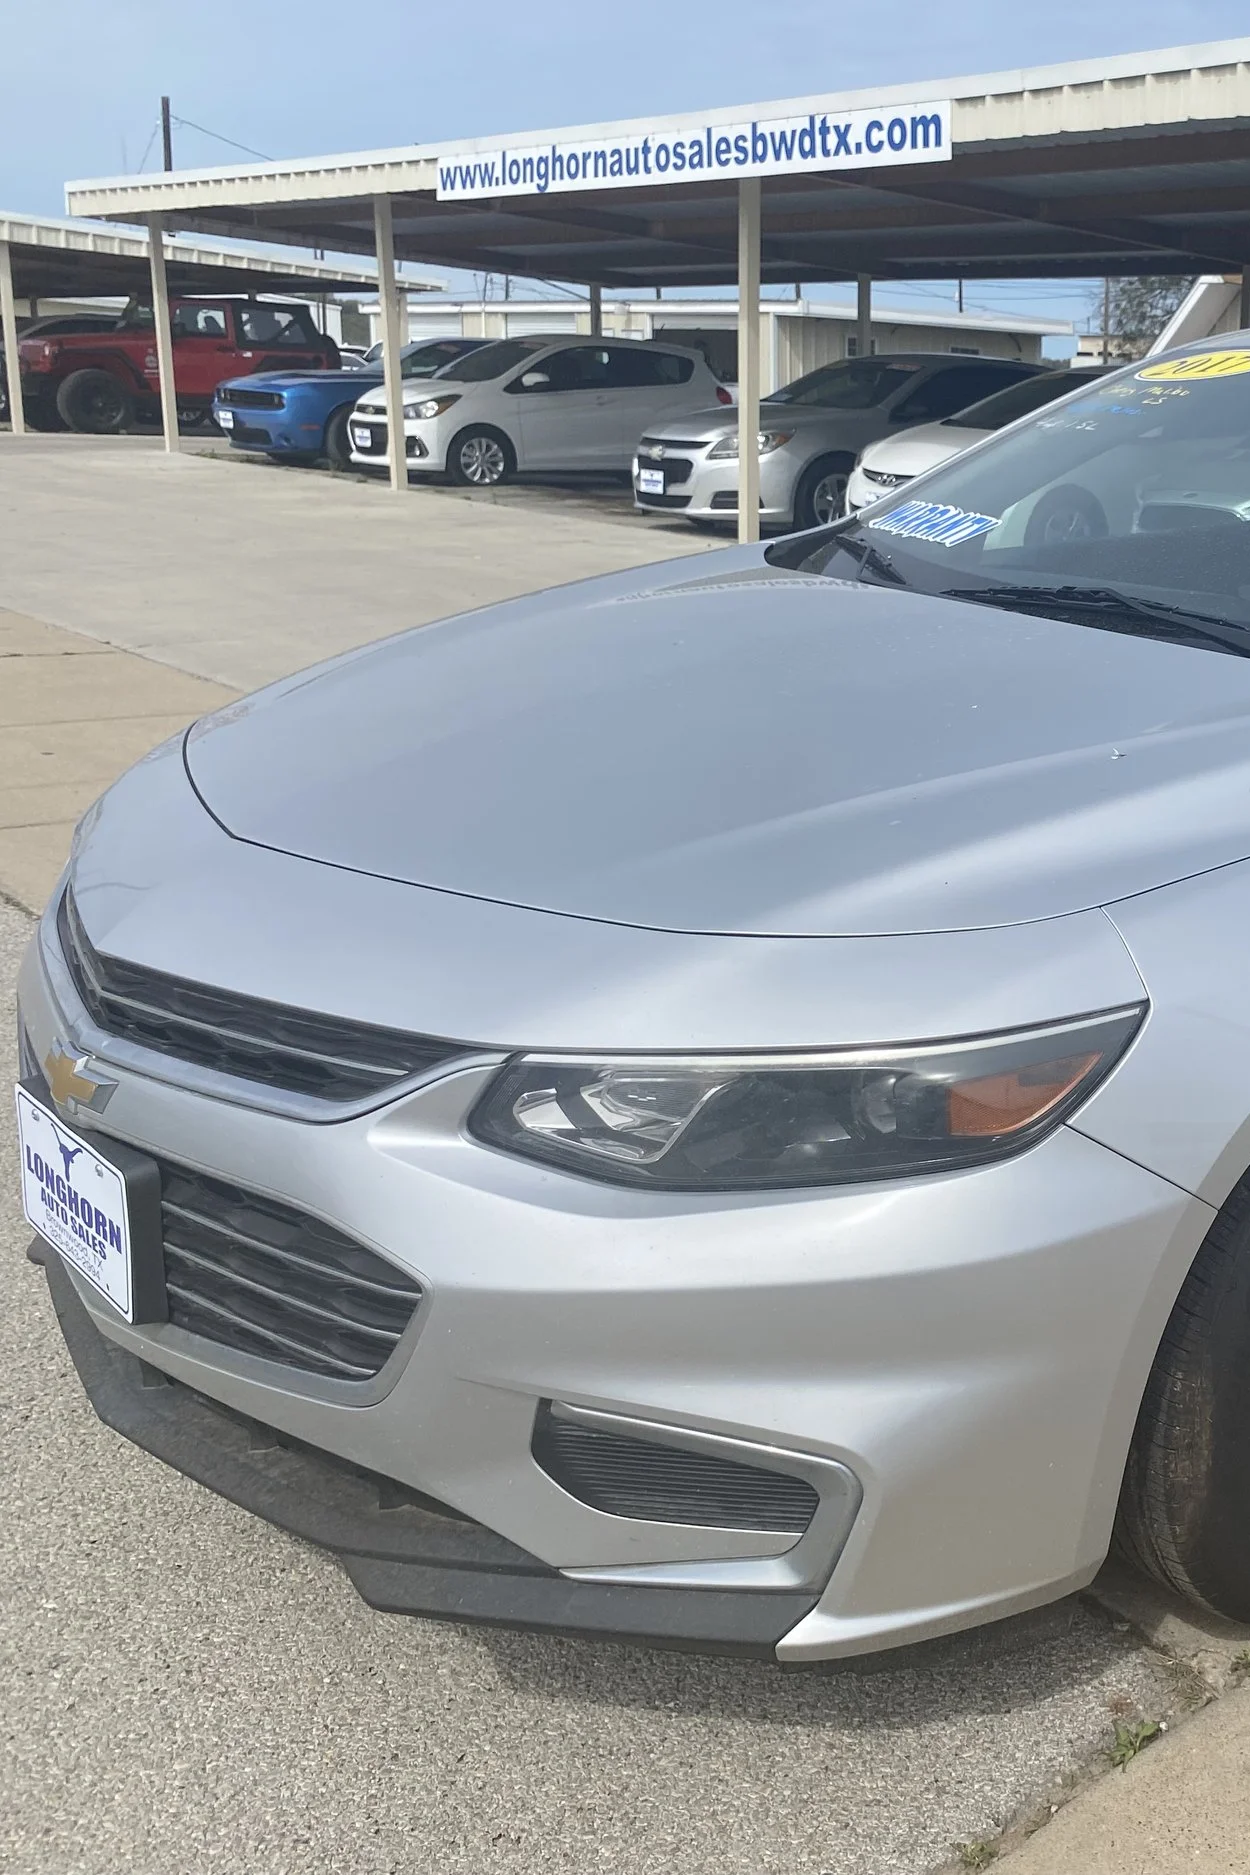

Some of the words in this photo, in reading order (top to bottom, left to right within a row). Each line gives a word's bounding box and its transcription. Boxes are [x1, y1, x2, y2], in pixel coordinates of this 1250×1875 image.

[439, 113, 943, 193] www.longhornautosalesbwdtx.com
[870, 501, 1002, 546] WARRANTY
[26, 1144, 122, 1255] LONGHORN
[41, 1186, 68, 1226] AUTO
[70, 1215, 107, 1260] SALES
